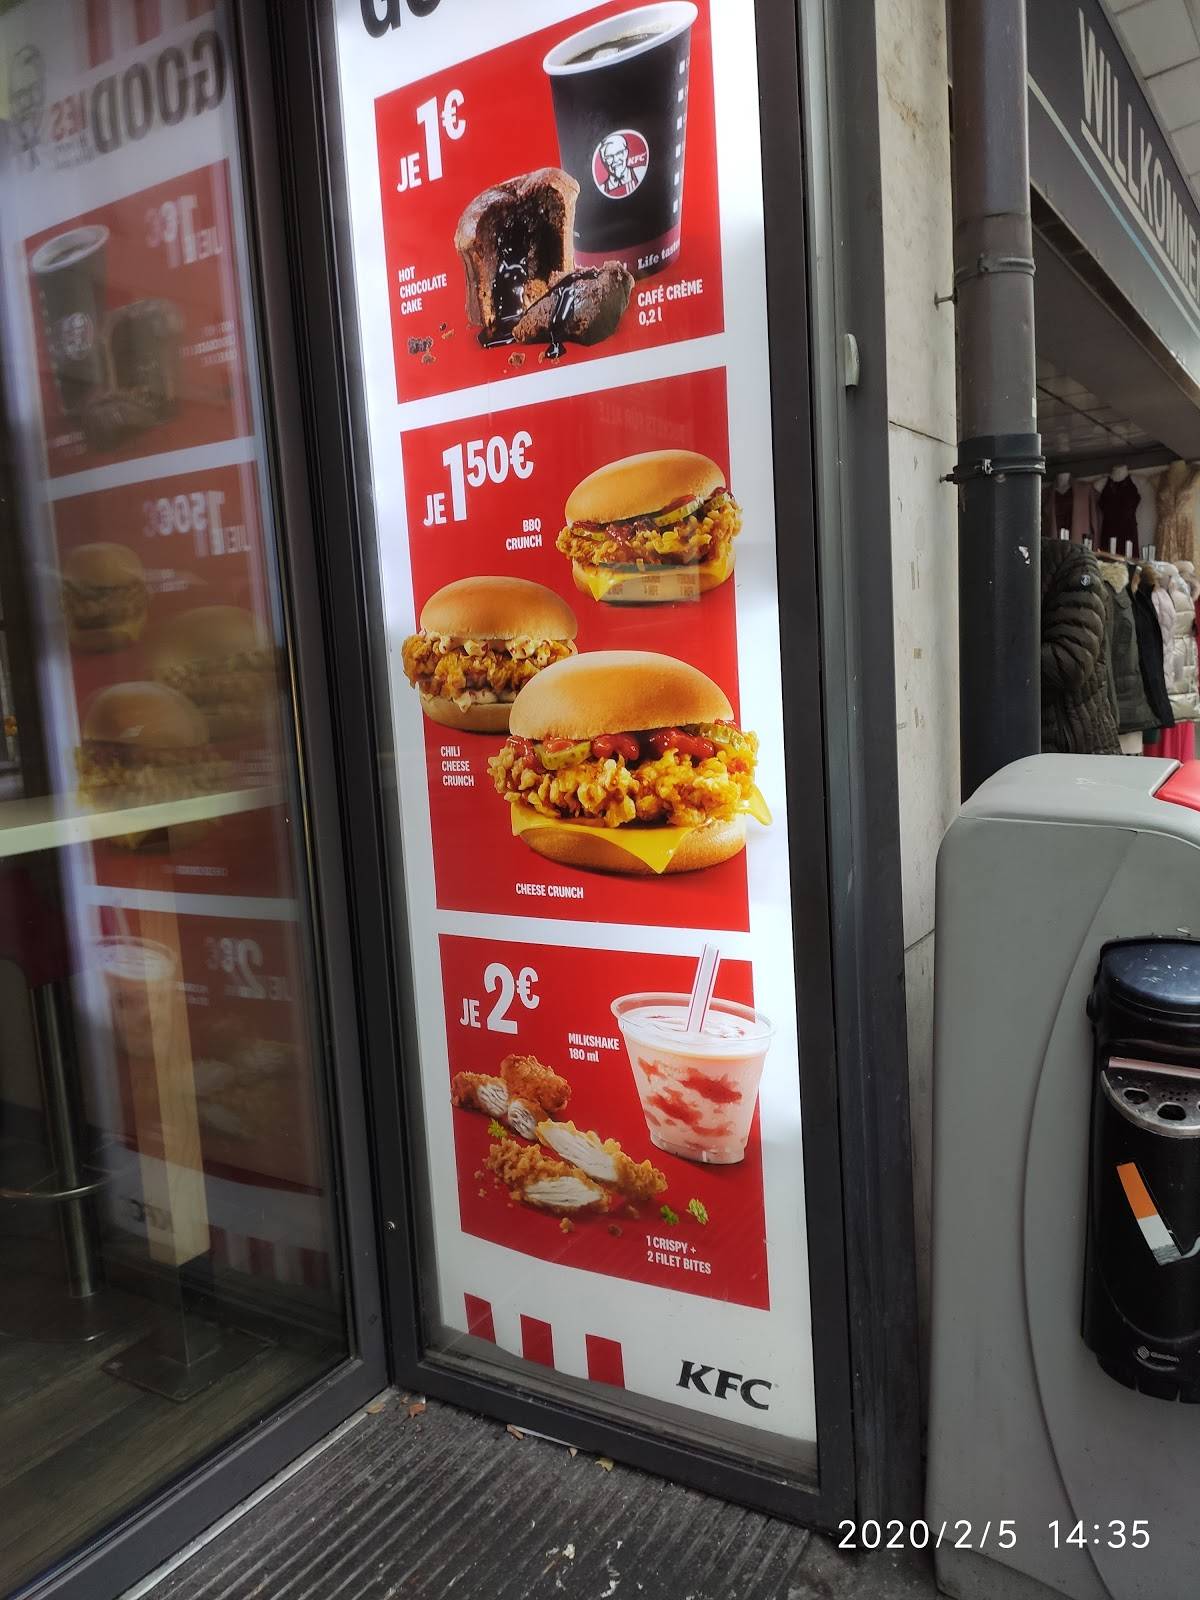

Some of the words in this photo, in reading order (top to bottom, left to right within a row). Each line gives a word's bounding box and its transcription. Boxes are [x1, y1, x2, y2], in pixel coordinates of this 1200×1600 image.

[627, 152, 647, 167] KFC
[397, 152, 422, 192] JE
[637, 254, 660, 270] Life
[398, 266, 416, 282] HOT
[399, 273, 447, 299] CHOCOLATE
[637, 284, 665, 307] CAFÉ
[666, 279, 704, 301] CRÈME
[401, 297, 422, 315] CAKE
[638, 309, 656, 327] 0,2
[423, 493, 447, 526] JE
[522, 518, 541, 533] BBQ
[505, 535, 542, 550] CRUNCH
[440, 746, 461, 758] CHILI
[441, 761, 470, 772] CHEESE
[442, 775, 474, 787] CRUNCH
[515, 883, 546, 897] CHEESE
[547, 886, 584, 899] CRUNCH
[460, 998, 481, 1029] JE
[483, 962, 540, 1035] 2€
[568, 1032, 619, 1050] MILKSHAKE
[568, 1048, 585, 1061] 180
[586, 1051, 599, 1062] ml
[646, 1235, 652, 1247] 1
[652, 1238, 688, 1254] CRISPY
[647, 1251, 654, 1263] 2
[655, 1253, 681, 1268] FILET
[683, 1259, 711, 1274] BITES
[675, 1359, 772, 1411] KFC
